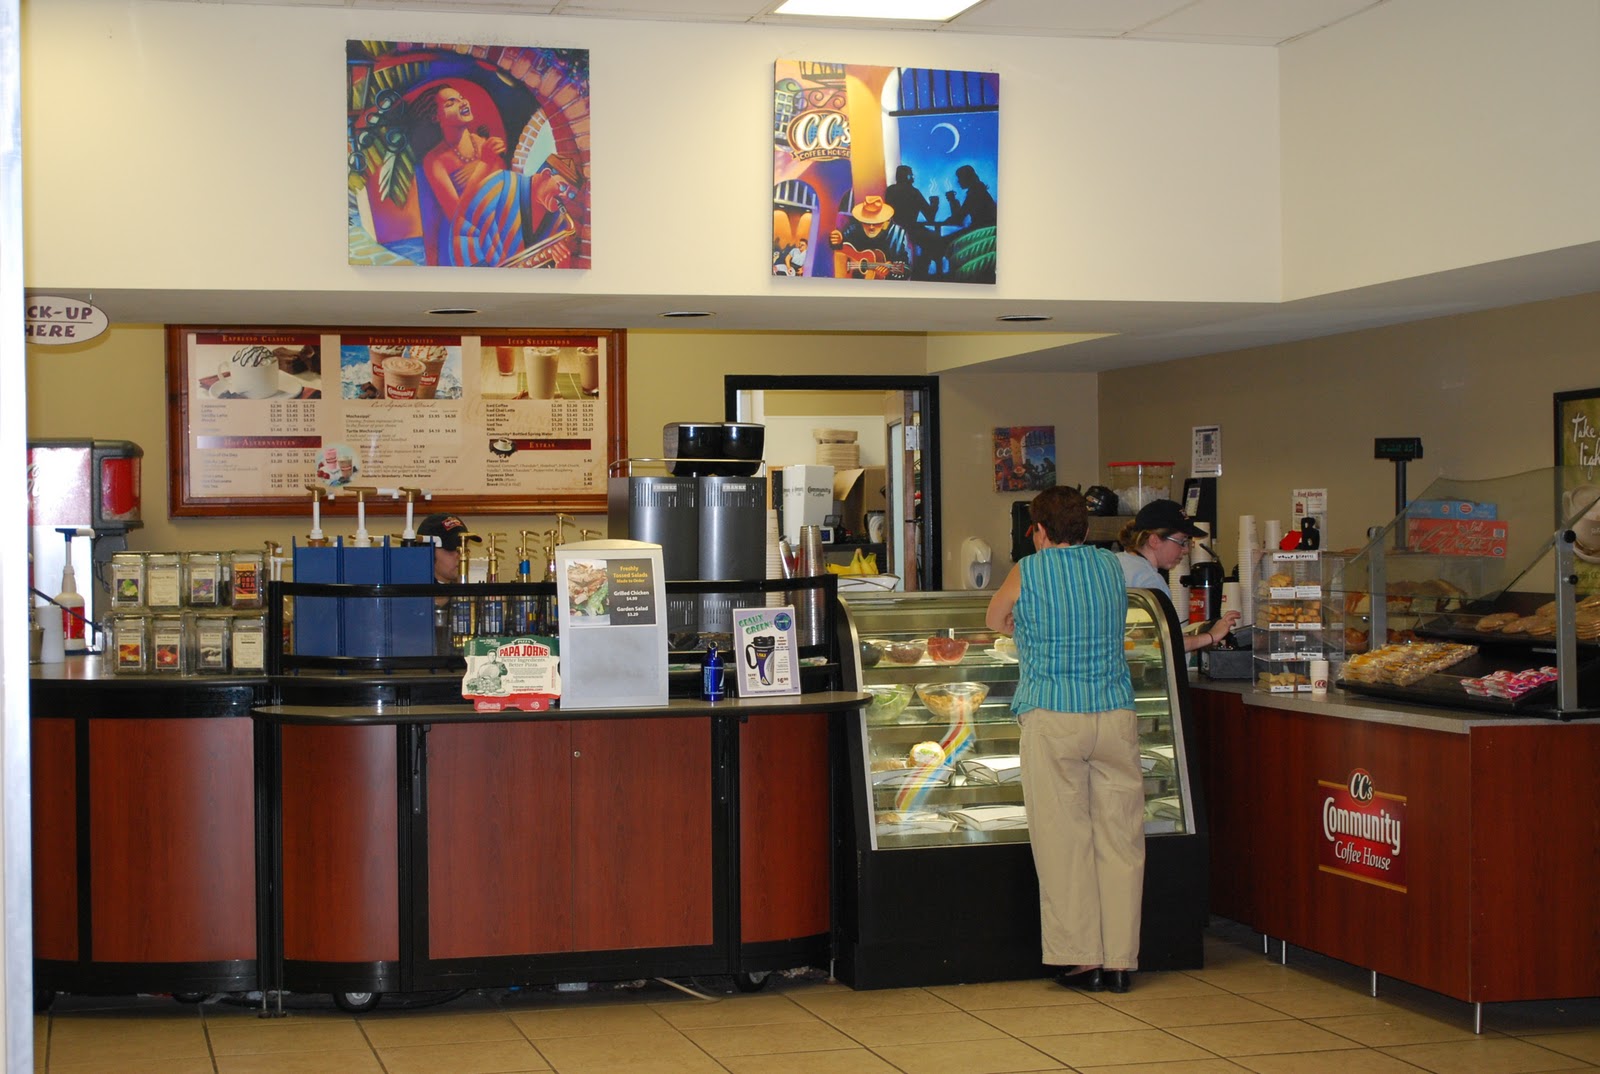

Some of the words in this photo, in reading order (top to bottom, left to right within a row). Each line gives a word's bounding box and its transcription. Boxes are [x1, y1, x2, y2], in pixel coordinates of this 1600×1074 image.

[800, 149, 827, 160] COFFEE
[28, 306, 93, 320] CK-UP
[261, 334, 295, 342] CLASSICS
[1572, 412, 1596, 442] Take
[500, 647, 520, 656] PAPA
[1351, 772, 1372, 800] CC's
[1323, 797, 1401, 856] Community
[1335, 840, 1362, 864] Coffee
[1362, 847, 1391, 871] House
